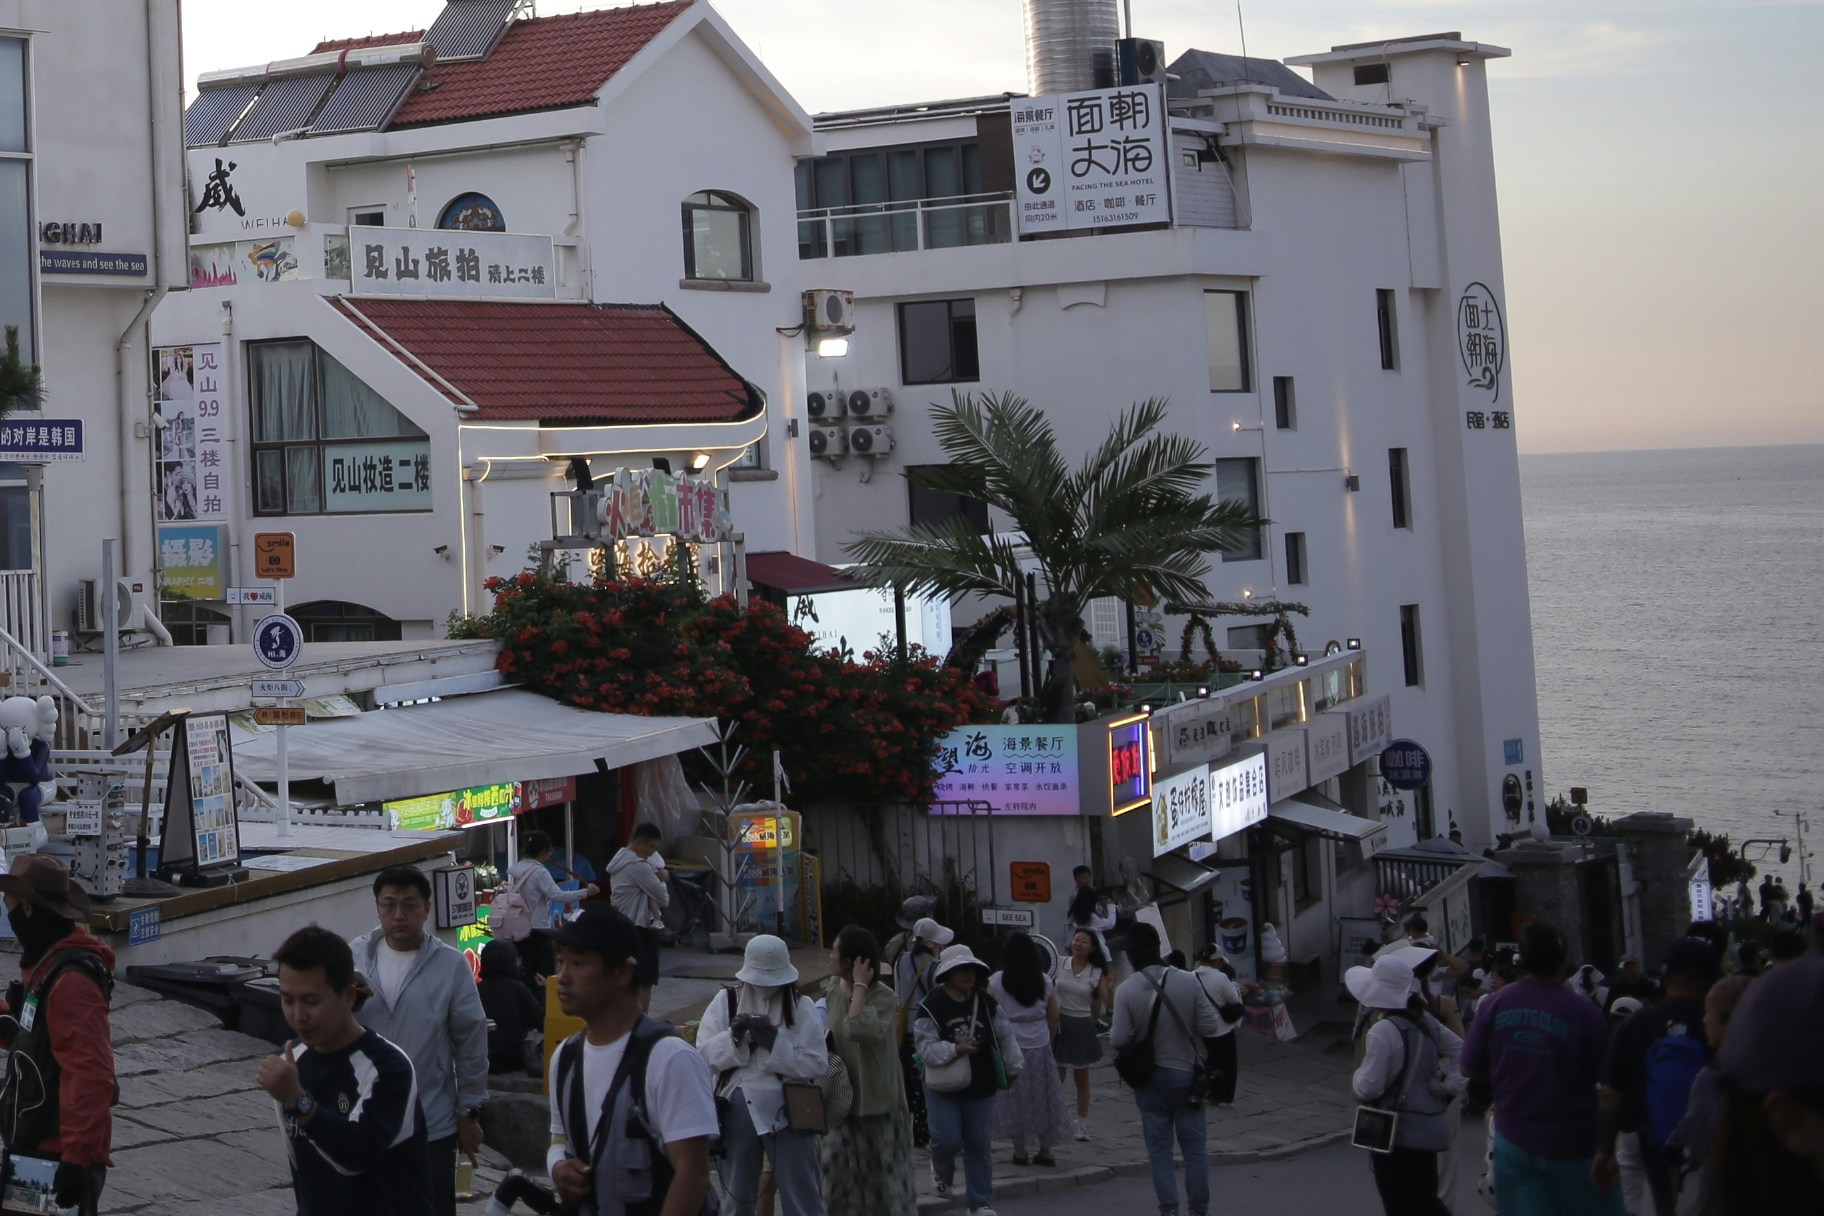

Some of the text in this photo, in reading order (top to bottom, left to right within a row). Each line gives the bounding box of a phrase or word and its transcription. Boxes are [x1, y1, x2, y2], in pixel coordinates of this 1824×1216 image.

[1014, 108, 1053, 123] 海景餐厅
[1066, 90, 1150, 137] 面朝
[195, 157, 245, 217] 威
[1072, 183, 1098, 191] FACING
[1130, 178, 1155, 186] HOTEL
[241, 217, 289, 230] WEIHA
[1093, 213, 1139, 223] 15163161509
[54, 259, 80, 269] waves
[82, 259, 98, 269] and
[100, 262, 114, 270] see
[116, 260, 129, 270] the
[131, 263, 144, 271] sea
[364, 244, 546, 285] 见山旅拍 请上二楼
[332, 453, 430, 495] 见山妆造二楼
[267, 538, 290, 547] smile
[162, 538, 214, 567] 摄影
[163, 577, 193, 585] RAPHY
[1002, 736, 1064, 752] 海景餐厅
[1385, 750, 1425, 768] 咖啡
[968, 763, 991, 773] 拾光
[1005, 762, 1062, 774] 空调开放
[1389, 770, 1424, 780] 冰淇淋
[959, 783, 975, 791] 海鲜
[982, 783, 998, 791] 快餐
[1005, 783, 1029, 791] 家常菜
[1005, 802, 1037, 811] 左转院内
[1015, 914, 1026, 922] SEA
[1494, 1007, 1538, 1031] SPORTS
